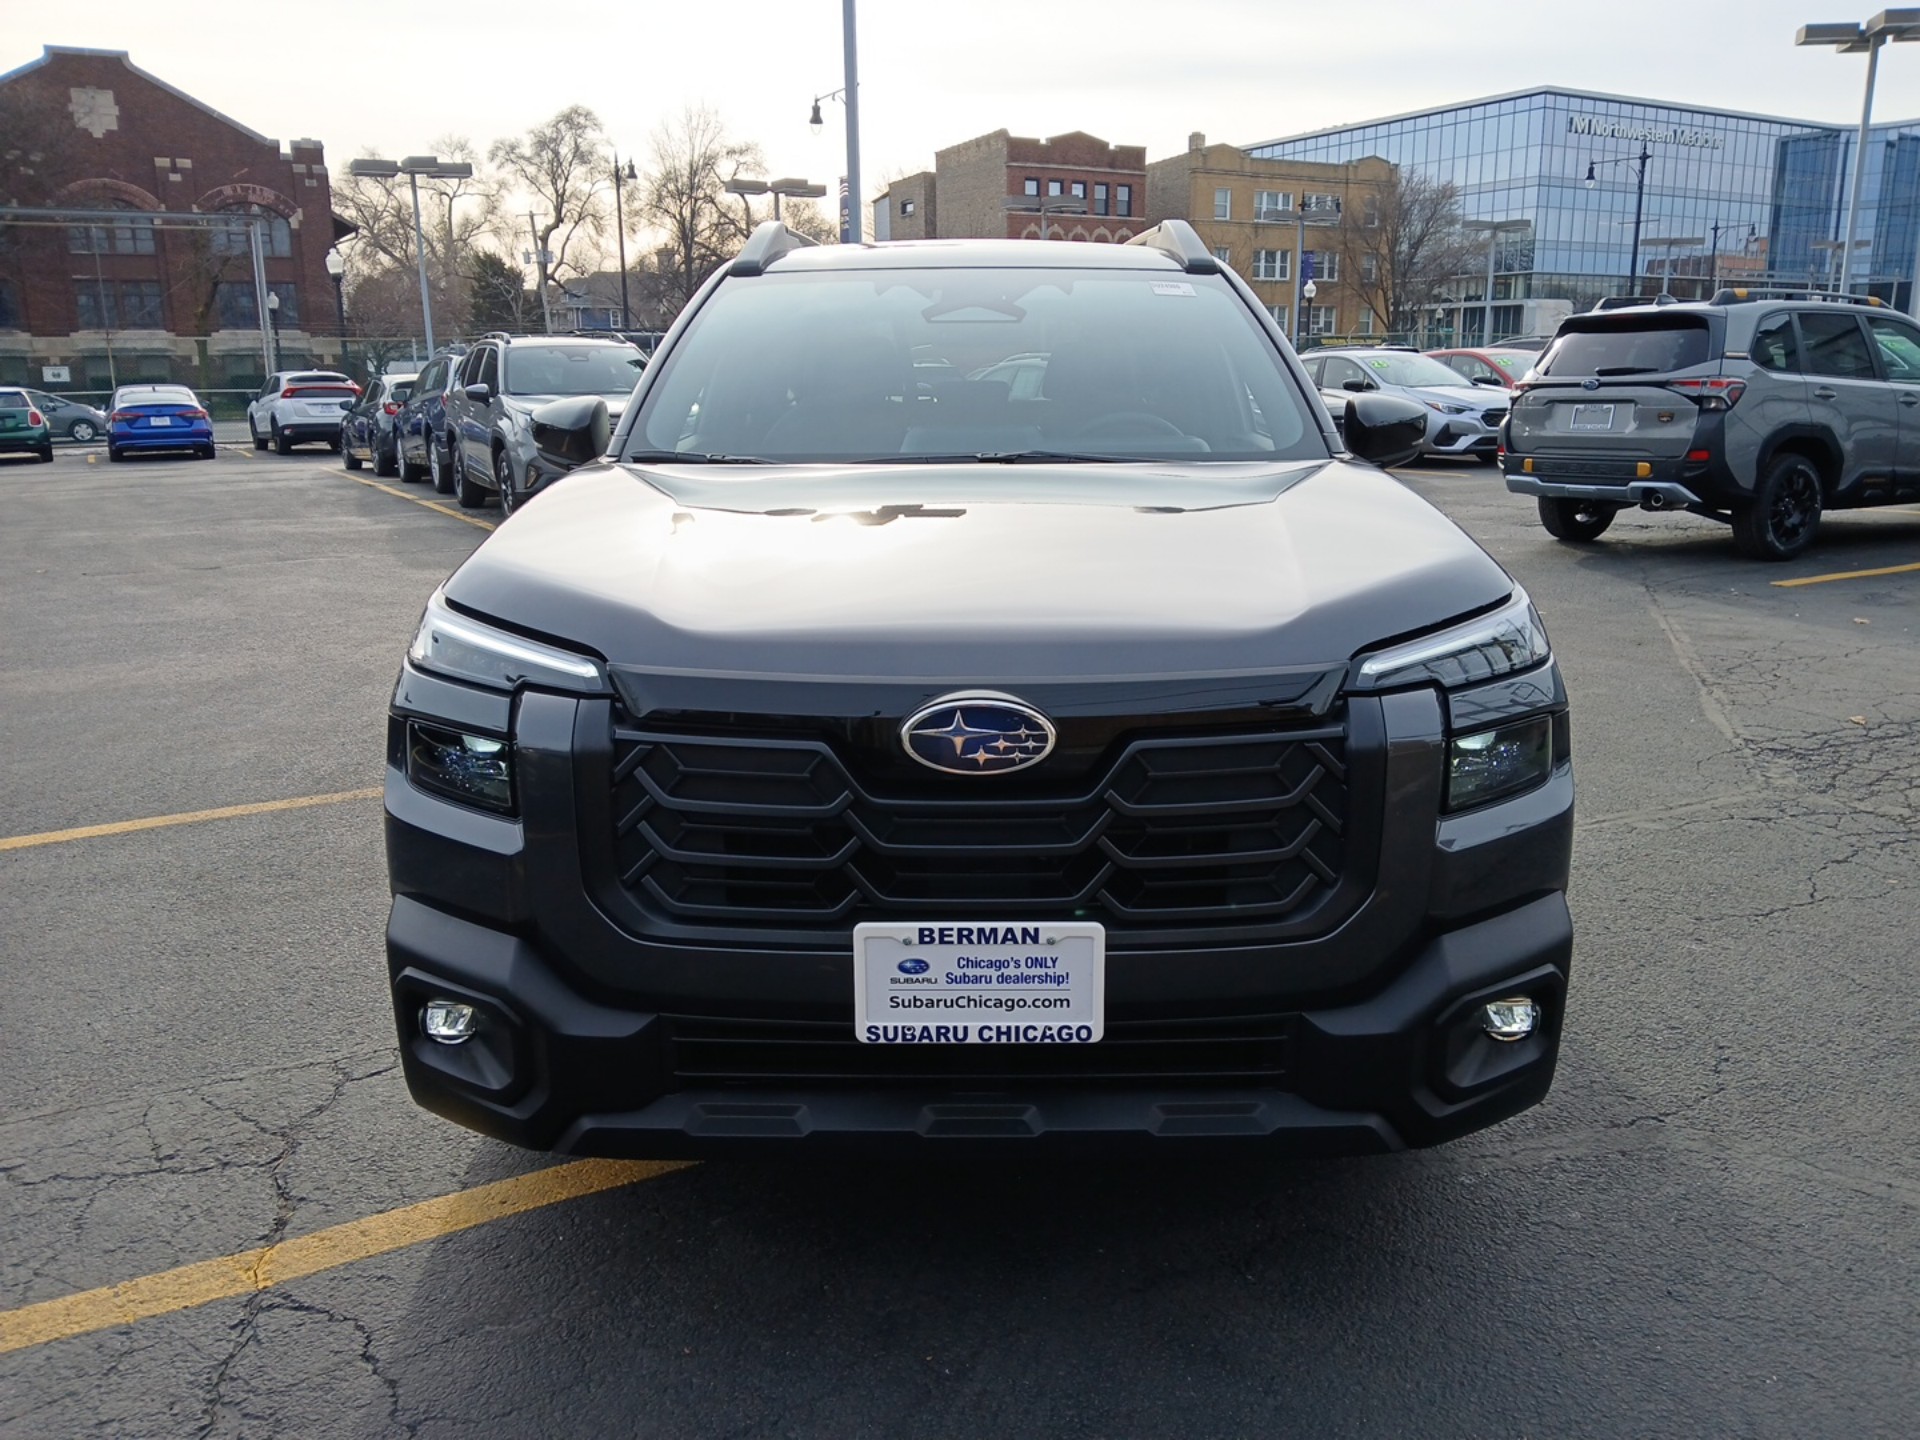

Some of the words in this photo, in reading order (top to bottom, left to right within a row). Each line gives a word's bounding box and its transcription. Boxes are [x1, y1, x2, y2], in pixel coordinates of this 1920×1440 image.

[1592, 119, 1675, 144] Northwestern
[918, 927, 1040, 945] BERMAN
[957, 956, 1021, 972] Chicago's
[1024, 956, 1059, 969] ONLY
[889, 977, 938, 985] SUBARU
[945, 972, 993, 985] Subaru
[996, 971, 1070, 987] dealership!
[889, 995, 1071, 1012] SubaruChicago.com
[866, 1025, 969, 1043] SUBARU
[978, 1024, 1093, 1043] CHICAGO
